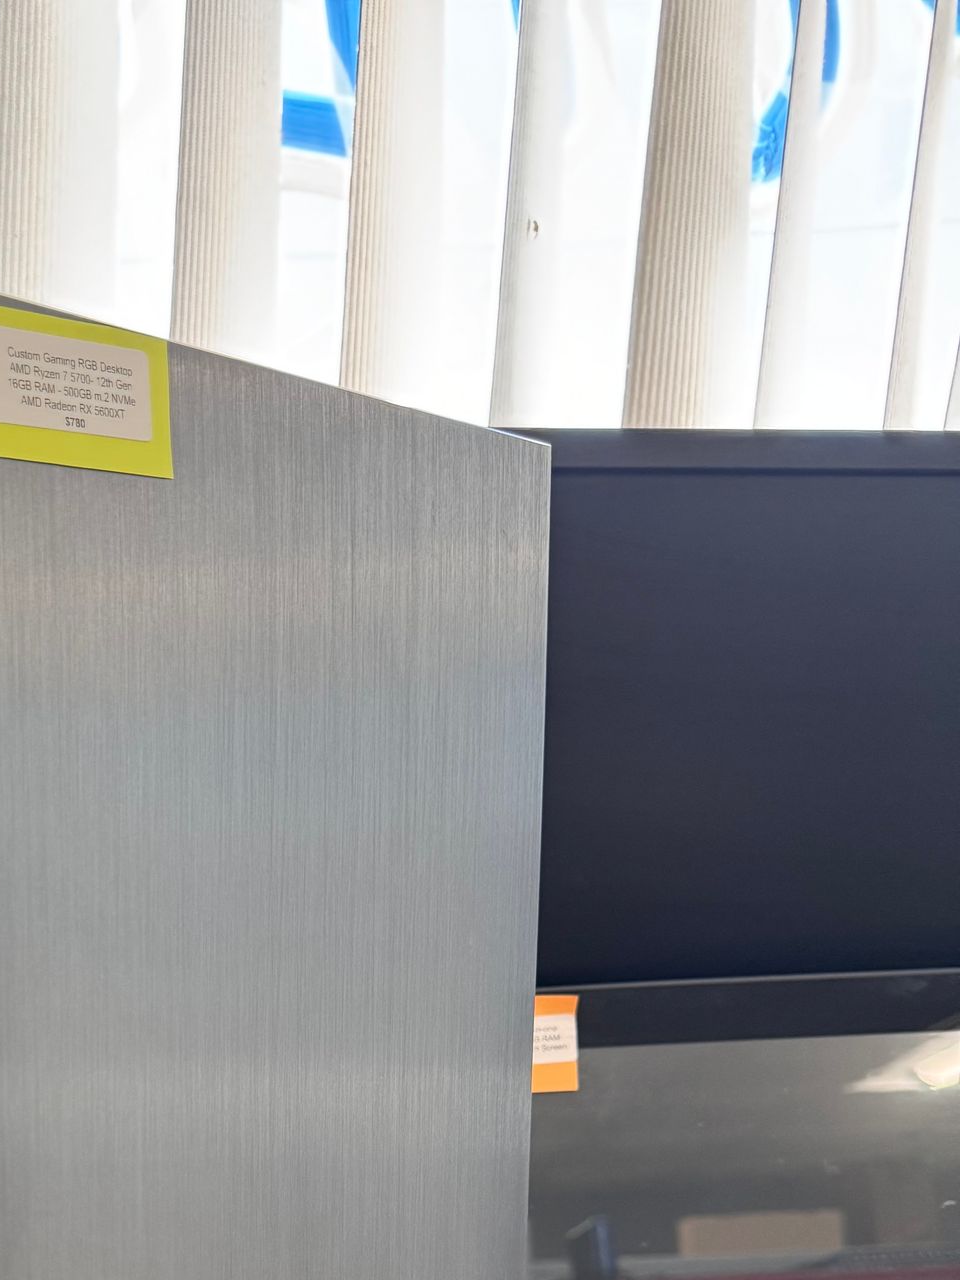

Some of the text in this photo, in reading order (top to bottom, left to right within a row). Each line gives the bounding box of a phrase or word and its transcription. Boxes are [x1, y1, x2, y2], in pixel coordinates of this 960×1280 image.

[8, 346, 132, 376] Custom Gaming RGB Desktop
[10, 362, 31, 375] AMD
[34, 366, 60, 379] Ryzen
[62, 370, 68, 380] 7
[96, 376, 113, 388] 12th
[116, 379, 132, 390] Gen
[8, 379, 32, 391] 16GB
[34, 382, 56, 394] RAM
[64, 386, 92, 400] 500GB
[94, 392, 110, 402] m.2
[112, 394, 136, 406] NVMe
[21, 395, 126, 420] AMD Radeon RX 5600XT
[64, 416, 86, 428] $780
